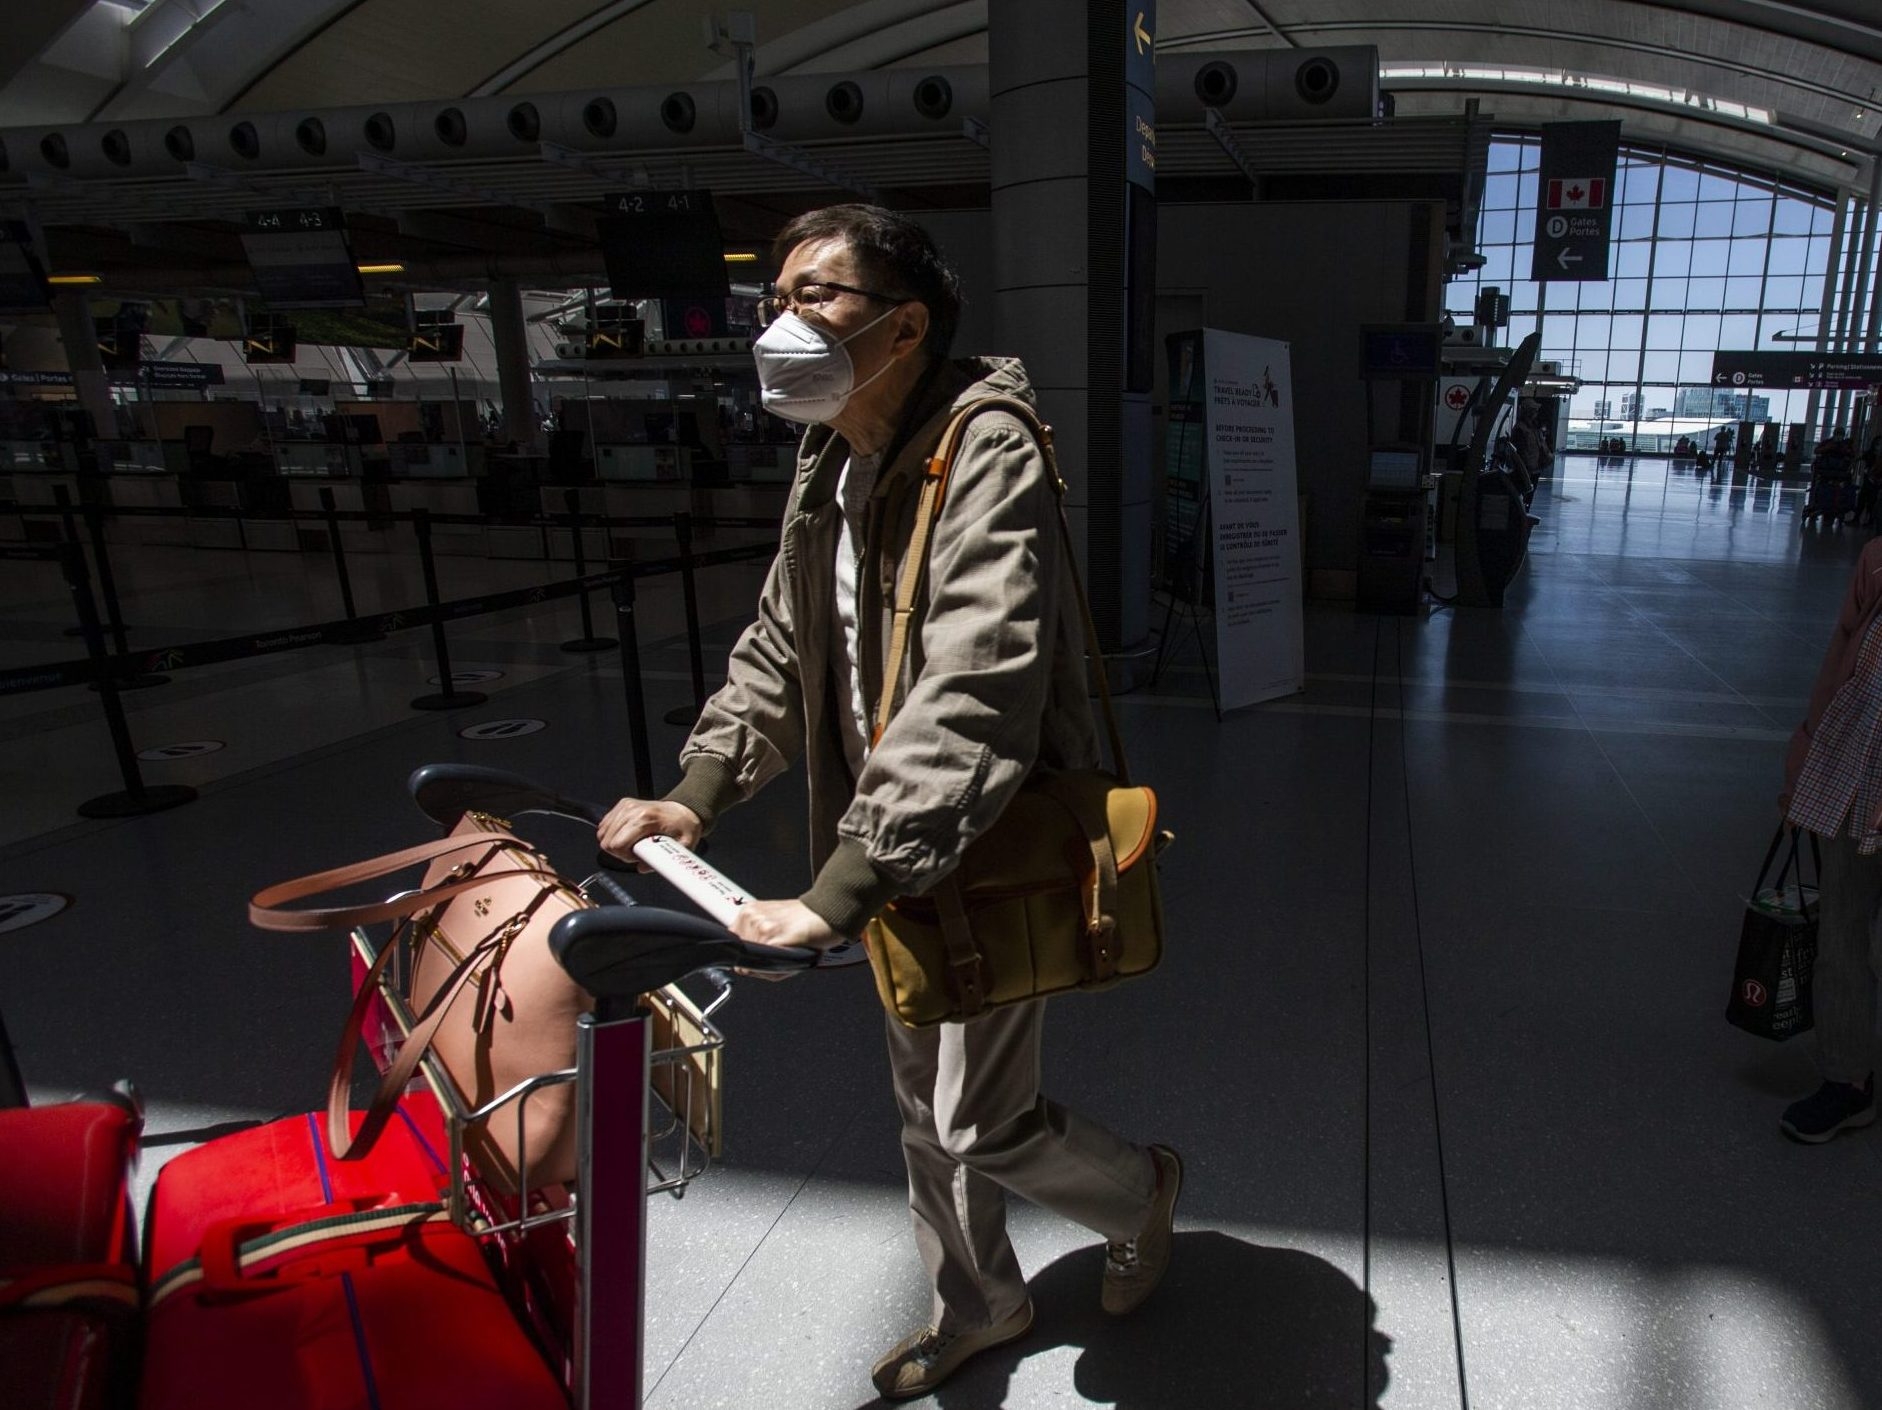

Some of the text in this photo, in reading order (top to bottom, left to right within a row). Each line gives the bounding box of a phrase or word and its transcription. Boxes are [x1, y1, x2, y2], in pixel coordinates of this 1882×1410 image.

[619, 194, 689, 213] 4-2 4-1
[258, 212, 322, 228] 4-4 4-3
[1570, 217, 1597, 226] Gates
[1569, 227, 1600, 237] Portes
